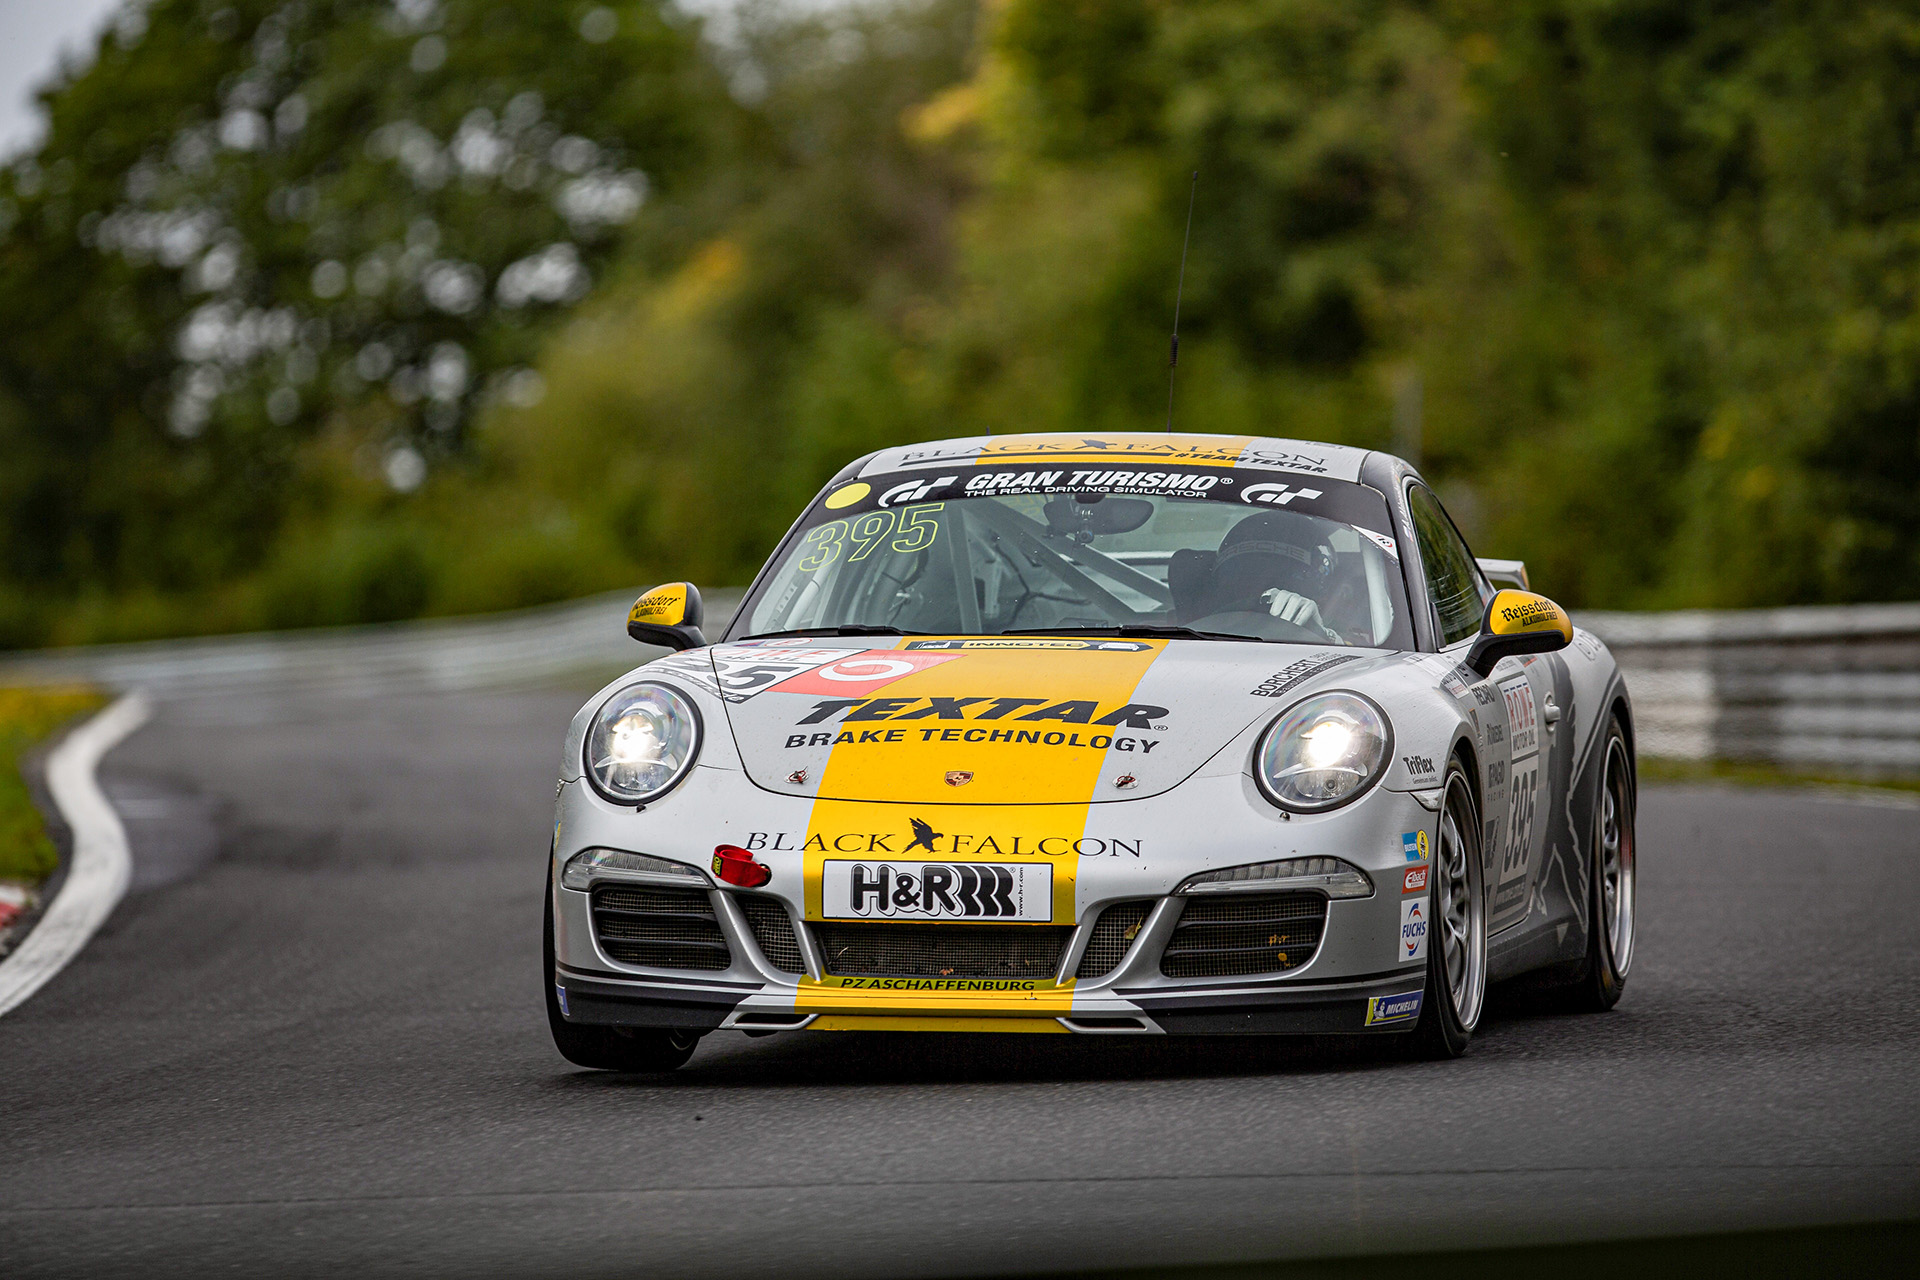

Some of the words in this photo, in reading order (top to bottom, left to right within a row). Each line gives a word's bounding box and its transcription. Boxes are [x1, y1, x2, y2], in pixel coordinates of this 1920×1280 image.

[902, 443, 1064, 461] BLACK
[1126, 443, 1329, 467] FALCON
[964, 470, 1065, 491] GRAN
[1070, 470, 1219, 491] TURISMO
[964, 489, 997, 498] THE
[999, 486, 1041, 495] REAL
[1044, 485, 1111, 494] DRIVING
[1113, 486, 1207, 498] SIMULATOR
[799, 502, 945, 572] 395
[1250, 659, 1321, 697] BORCHERT
[795, 697, 1170, 730] TEXTAR
[784, 729, 906, 749] BRAKE
[920, 728, 1160, 755] TECHNOLOGY
[1504, 769, 1537, 873] 395
[745, 832, 896, 853] BLACK
[951, 835, 1142, 858] FALCON
[851, 864, 959, 914] H&R
[1402, 921, 1426, 939] FUCHS
[840, 978, 866, 989] PZ
[868, 979, 1035, 991] ASCHAFFENBURG
[1386, 1000, 1418, 1015] MICHELIN
